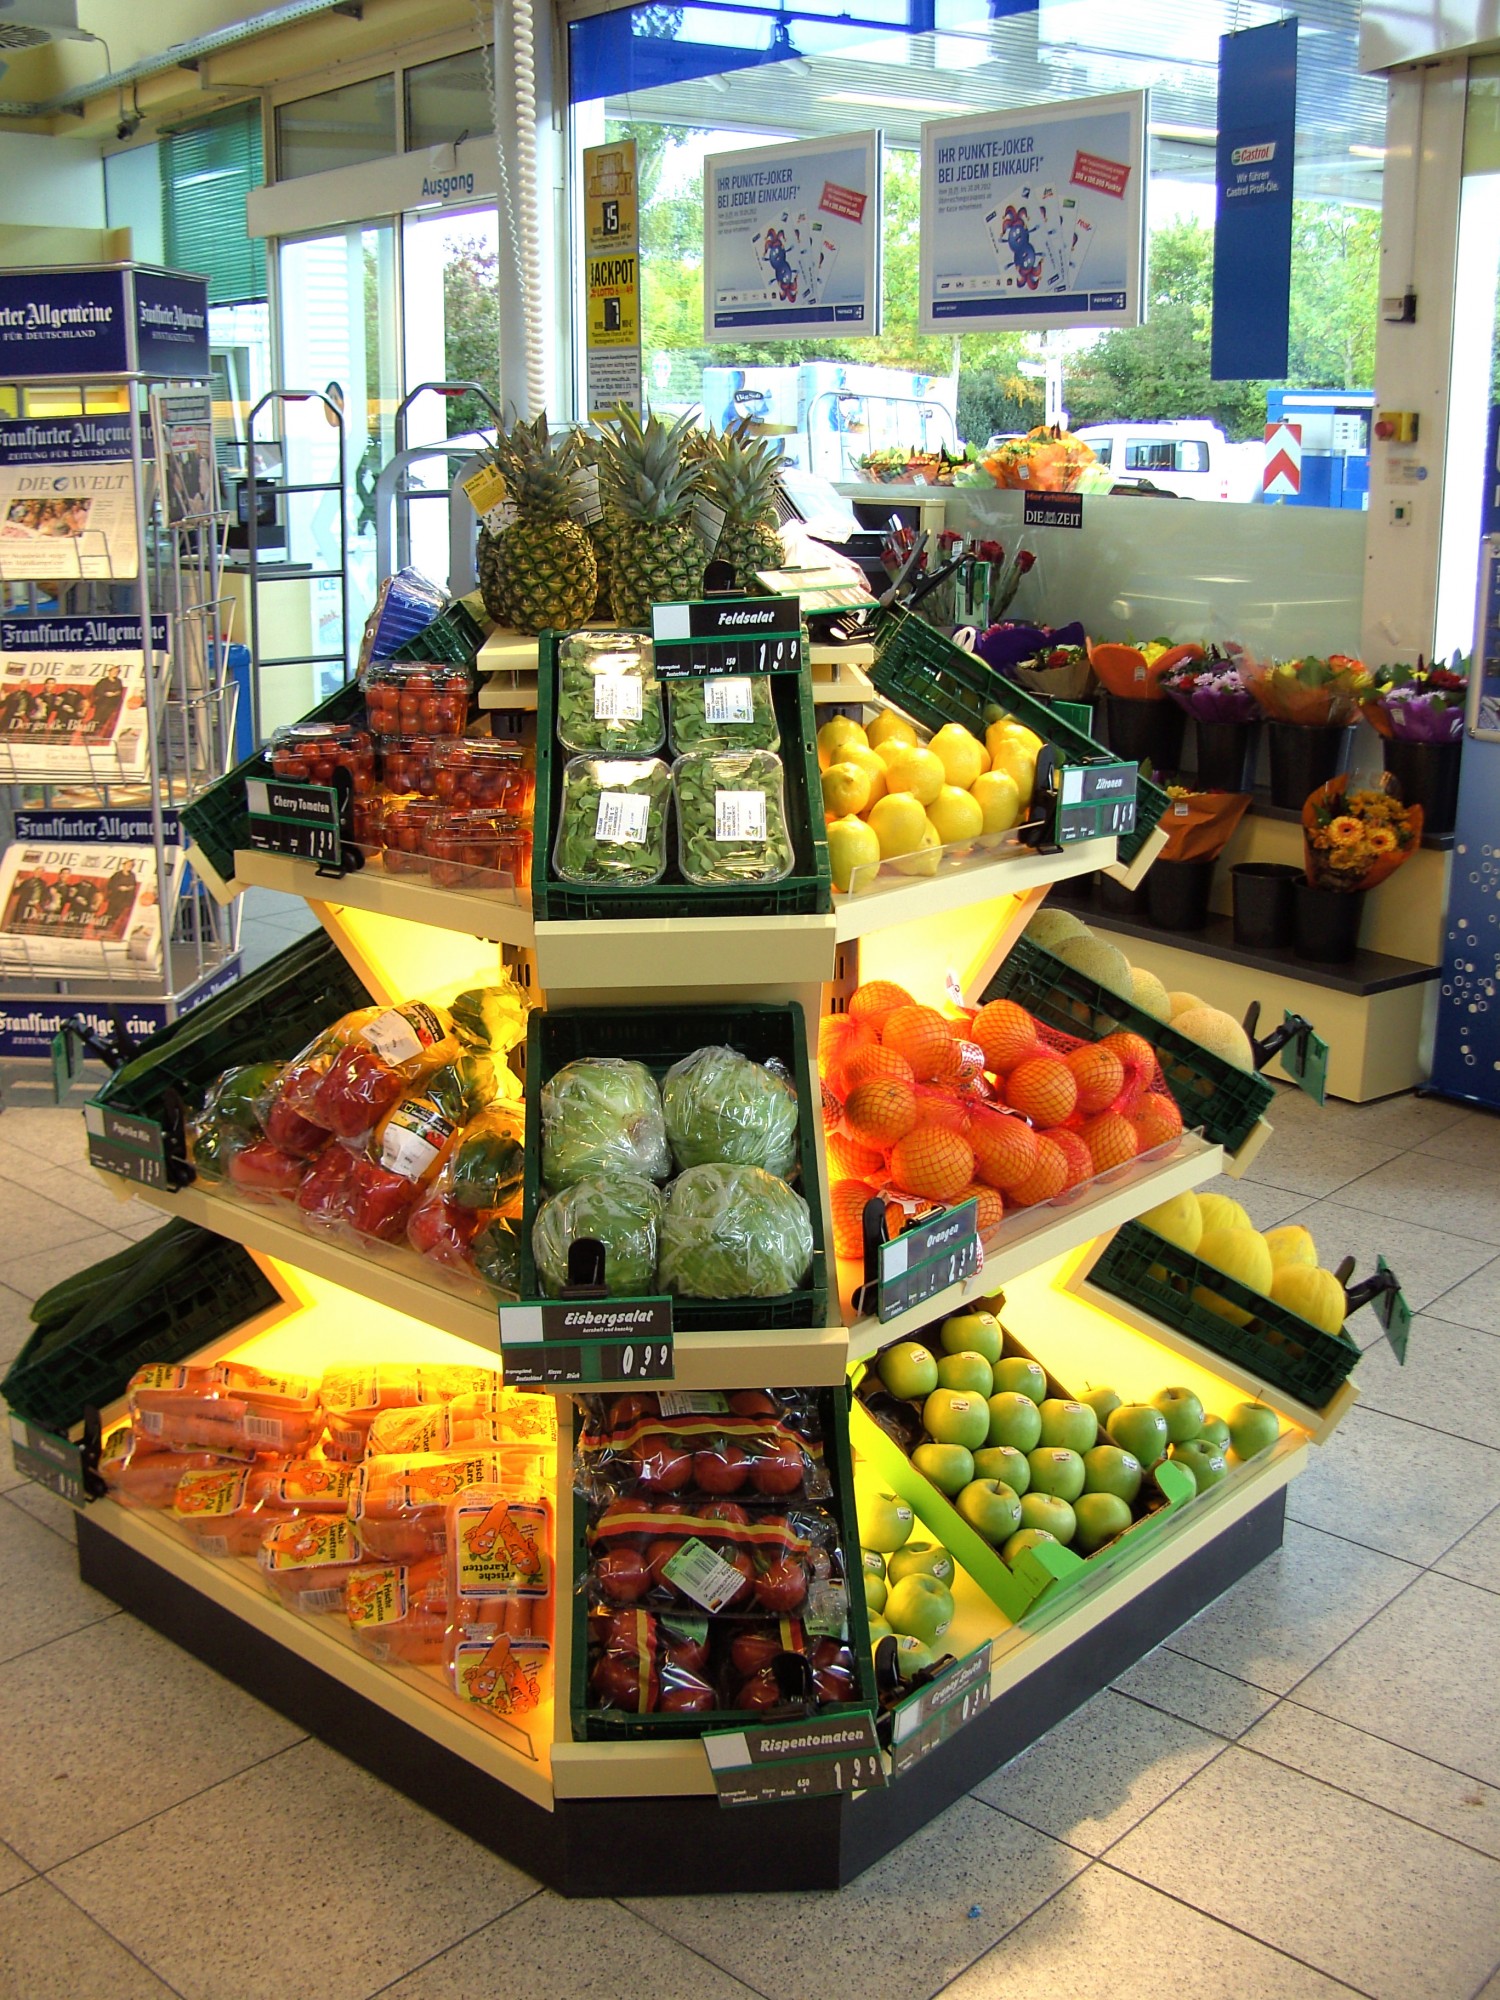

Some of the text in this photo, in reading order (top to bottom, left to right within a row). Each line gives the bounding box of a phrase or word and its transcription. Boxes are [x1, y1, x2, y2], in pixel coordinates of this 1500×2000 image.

[939, 136, 1034, 164] IHR PUNKTE-JOKER
[1241, 147, 1270, 162] Castrol
[717, 168, 793, 192] IHR PUNKTE-JOKER
[939, 167, 954, 183] BEI
[956, 163, 989, 182] JEDEM
[422, 173, 474, 198] Ausgang
[717, 195, 730, 209] BEI
[730, 191, 756, 207] JEDEM
[590, 259, 634, 287] JACKPOT
[26, 301, 113, 330] Allgemeine
[3, 330, 96, 341] FÜR DEUTSCHLAND
[72, 423, 154, 448] Allgemene
[8, 452, 48, 461] ZEITUNG
[72, 448, 131, 458] DEUTSCHLAN
[18, 475, 129, 492] DIE WELT
[1026, 511, 1080, 526] DIE ZEIT
[718, 611, 775, 625] Feldsalat
[2, 621, 165, 648] Frankfurter Allgemene
[29, 662, 65, 676] DIE
[726, 657, 736, 665] 150
[9, 718, 27, 730] Der
[1096, 779, 1123, 790] Zitronen
[274, 795, 330, 814] Cherry Tomaten
[17, 815, 177, 841] Frankfurter Allgemene
[44, 851, 81, 867] DIE
[23, 906, 46, 922] Der
[927, 1224, 959, 1248] Orangen
[564, 1309, 654, 1327] Eisbergsalat
[622, 1345, 668, 1376] 0.99
[476, 1459, 484, 1482] risch
[463, 1563, 509, 1573] Karotten
[479, 1572, 515, 1581] Frische
[383, 1583, 392, 1608] Frische
[376, 1591, 384, 1621] Karotten
[760, 1729, 864, 1752] Rispentomaten
[834, 1756, 876, 1790] 1.99
[797, 1778, 810, 1787] 650
